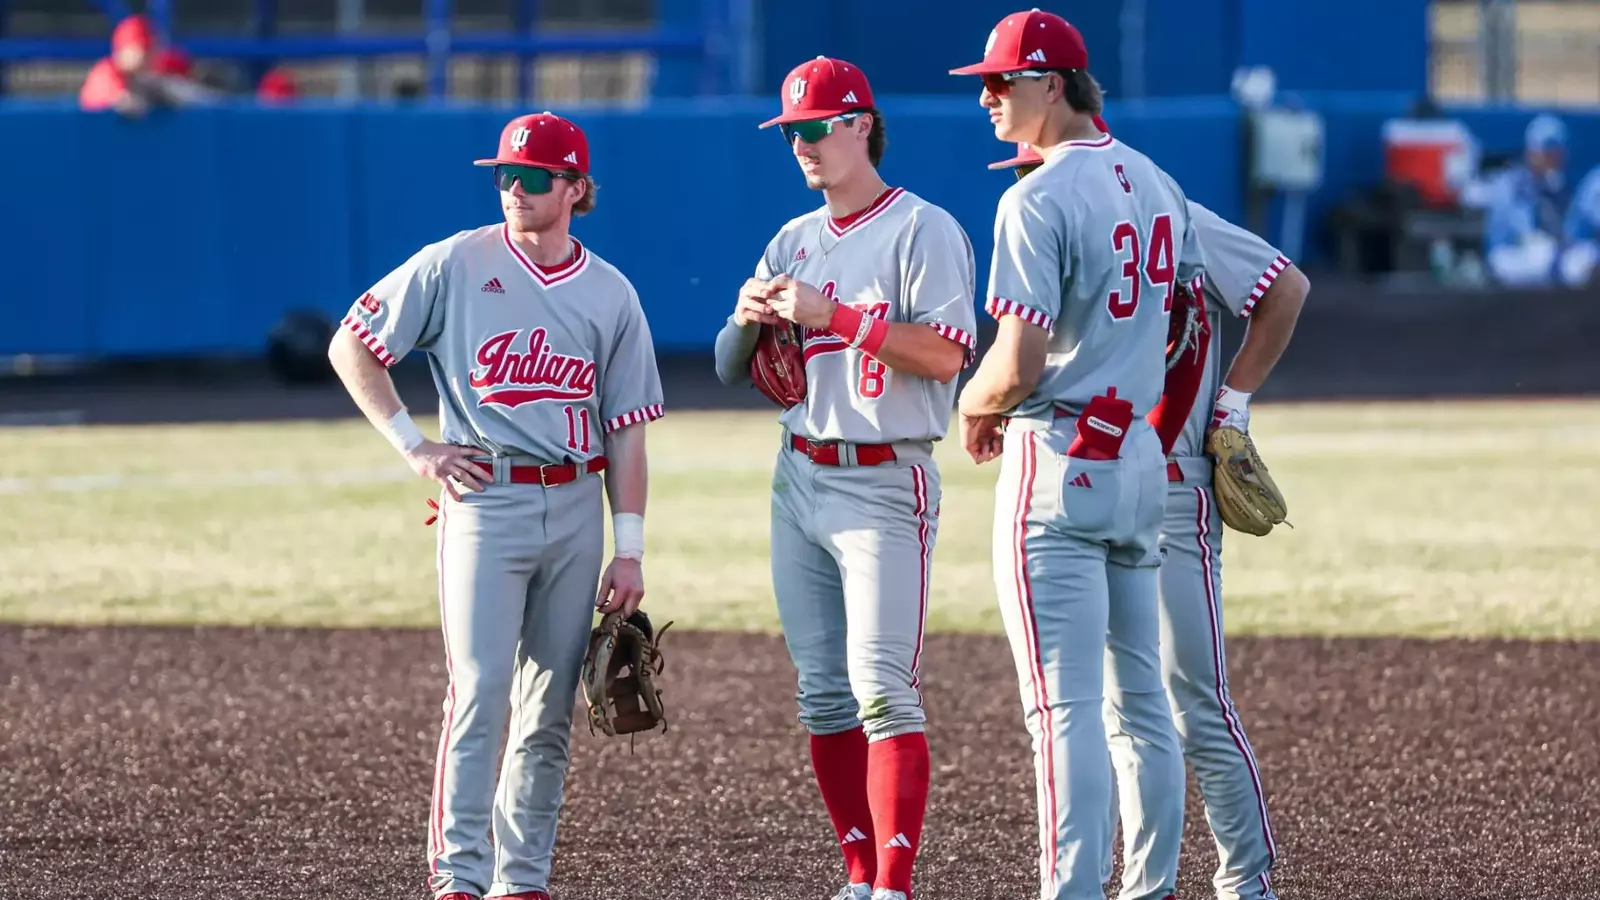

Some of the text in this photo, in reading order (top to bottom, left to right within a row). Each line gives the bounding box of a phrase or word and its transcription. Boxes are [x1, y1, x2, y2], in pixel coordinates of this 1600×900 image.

[1106, 212, 1175, 322] 34
[468, 326, 597, 409] Indiana
[857, 351, 888, 400] 8
[562, 404, 591, 454] 11
